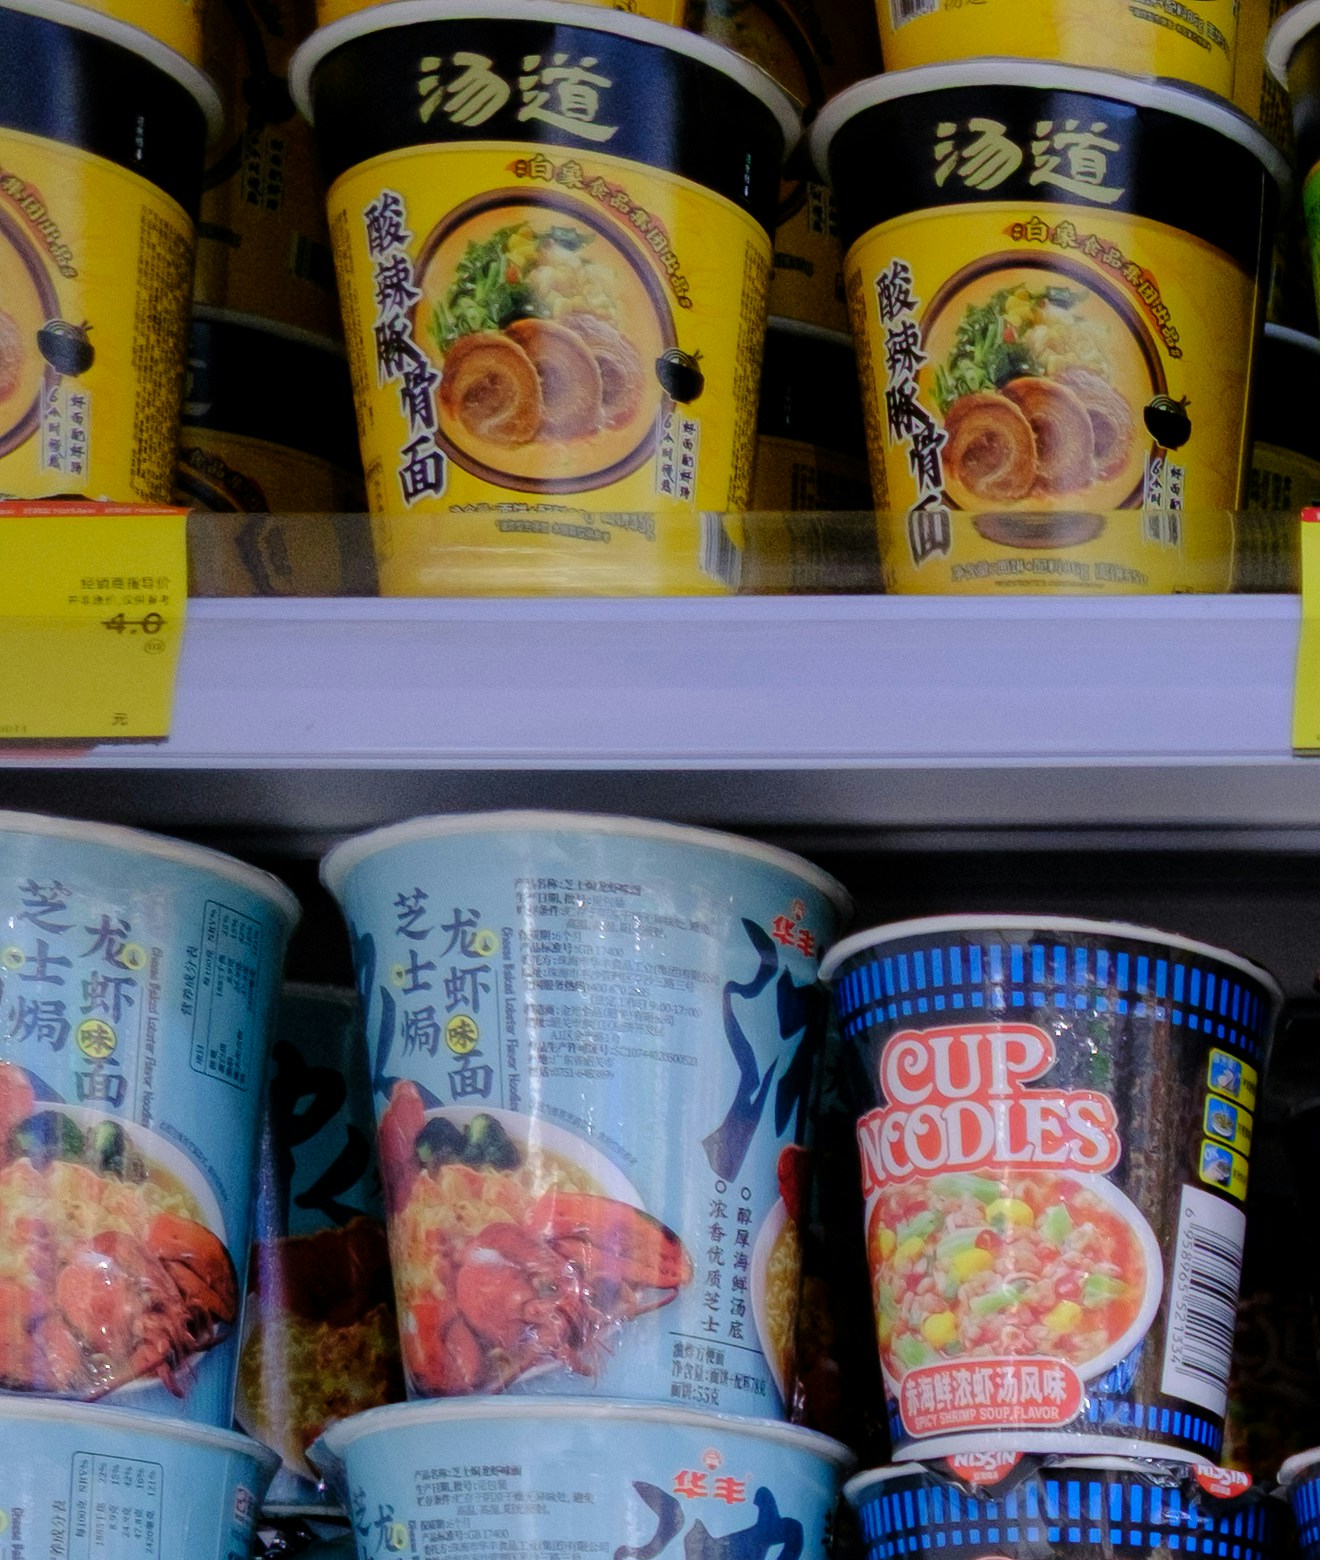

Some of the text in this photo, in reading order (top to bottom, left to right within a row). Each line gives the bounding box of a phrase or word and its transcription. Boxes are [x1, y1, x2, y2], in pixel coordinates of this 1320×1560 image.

[416, 52, 619, 144] 汤道
[932, 120, 1126, 204] 汤道
[361, 190, 448, 501] 酸辣豚骨面
[872, 260, 953, 565] 酸辣豚骨面
[102, 613, 165, 635] 4.0
[73, 912, 139, 1110] 龙虾味面
[440, 908, 496, 1102] 龙虾味面
[883, 1024, 1054, 1100] CUP
[858, 1091, 1118, 1176] NOODLES
[701, 1199, 730, 1337] 浓香优质芝士
[728, 1203, 759, 1341] 醇厚海鲜汤底
[670, 1468, 749, 1507] 华丰
